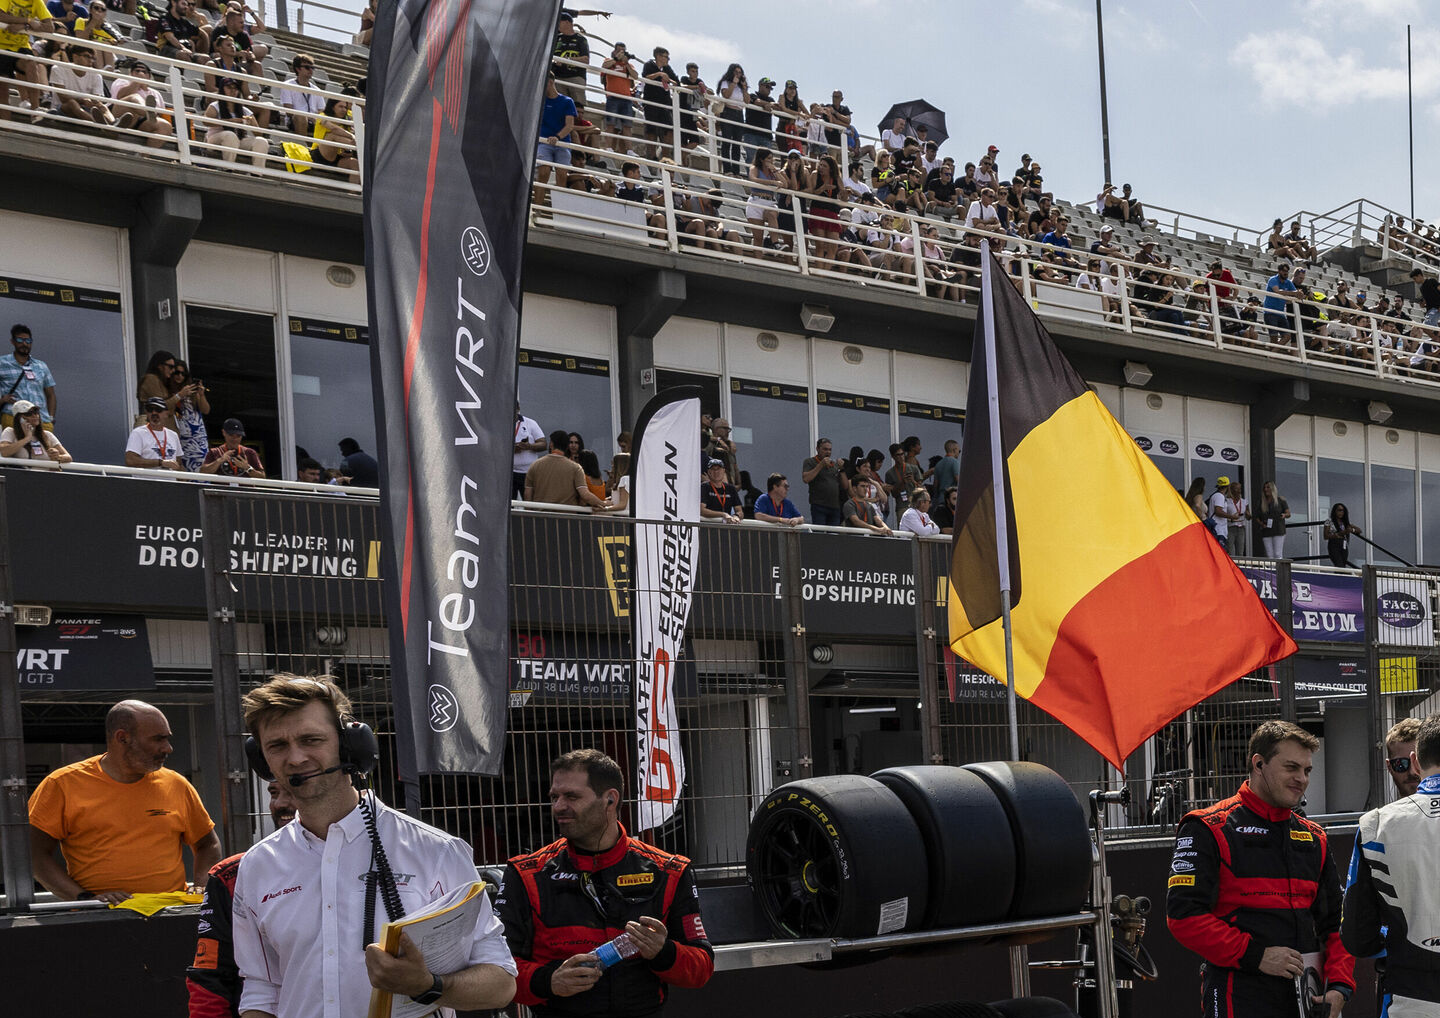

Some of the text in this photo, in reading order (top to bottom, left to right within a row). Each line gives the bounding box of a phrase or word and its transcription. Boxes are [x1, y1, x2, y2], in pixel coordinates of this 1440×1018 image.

[427, 277, 487, 665] Team WRT
[135, 525, 354, 552] EUROPN LEADER IN
[659, 440, 678, 636] EUROPEAN
[772, 567, 915, 585] EOPEAN LEADER IN
[1382, 600, 1419, 611] FACE
[27, 673, 54, 683] GT3
[517, 660, 578, 681] TEAM
[1178, 839, 1193, 847] OMP
[282, 885, 302, 895] Sport
